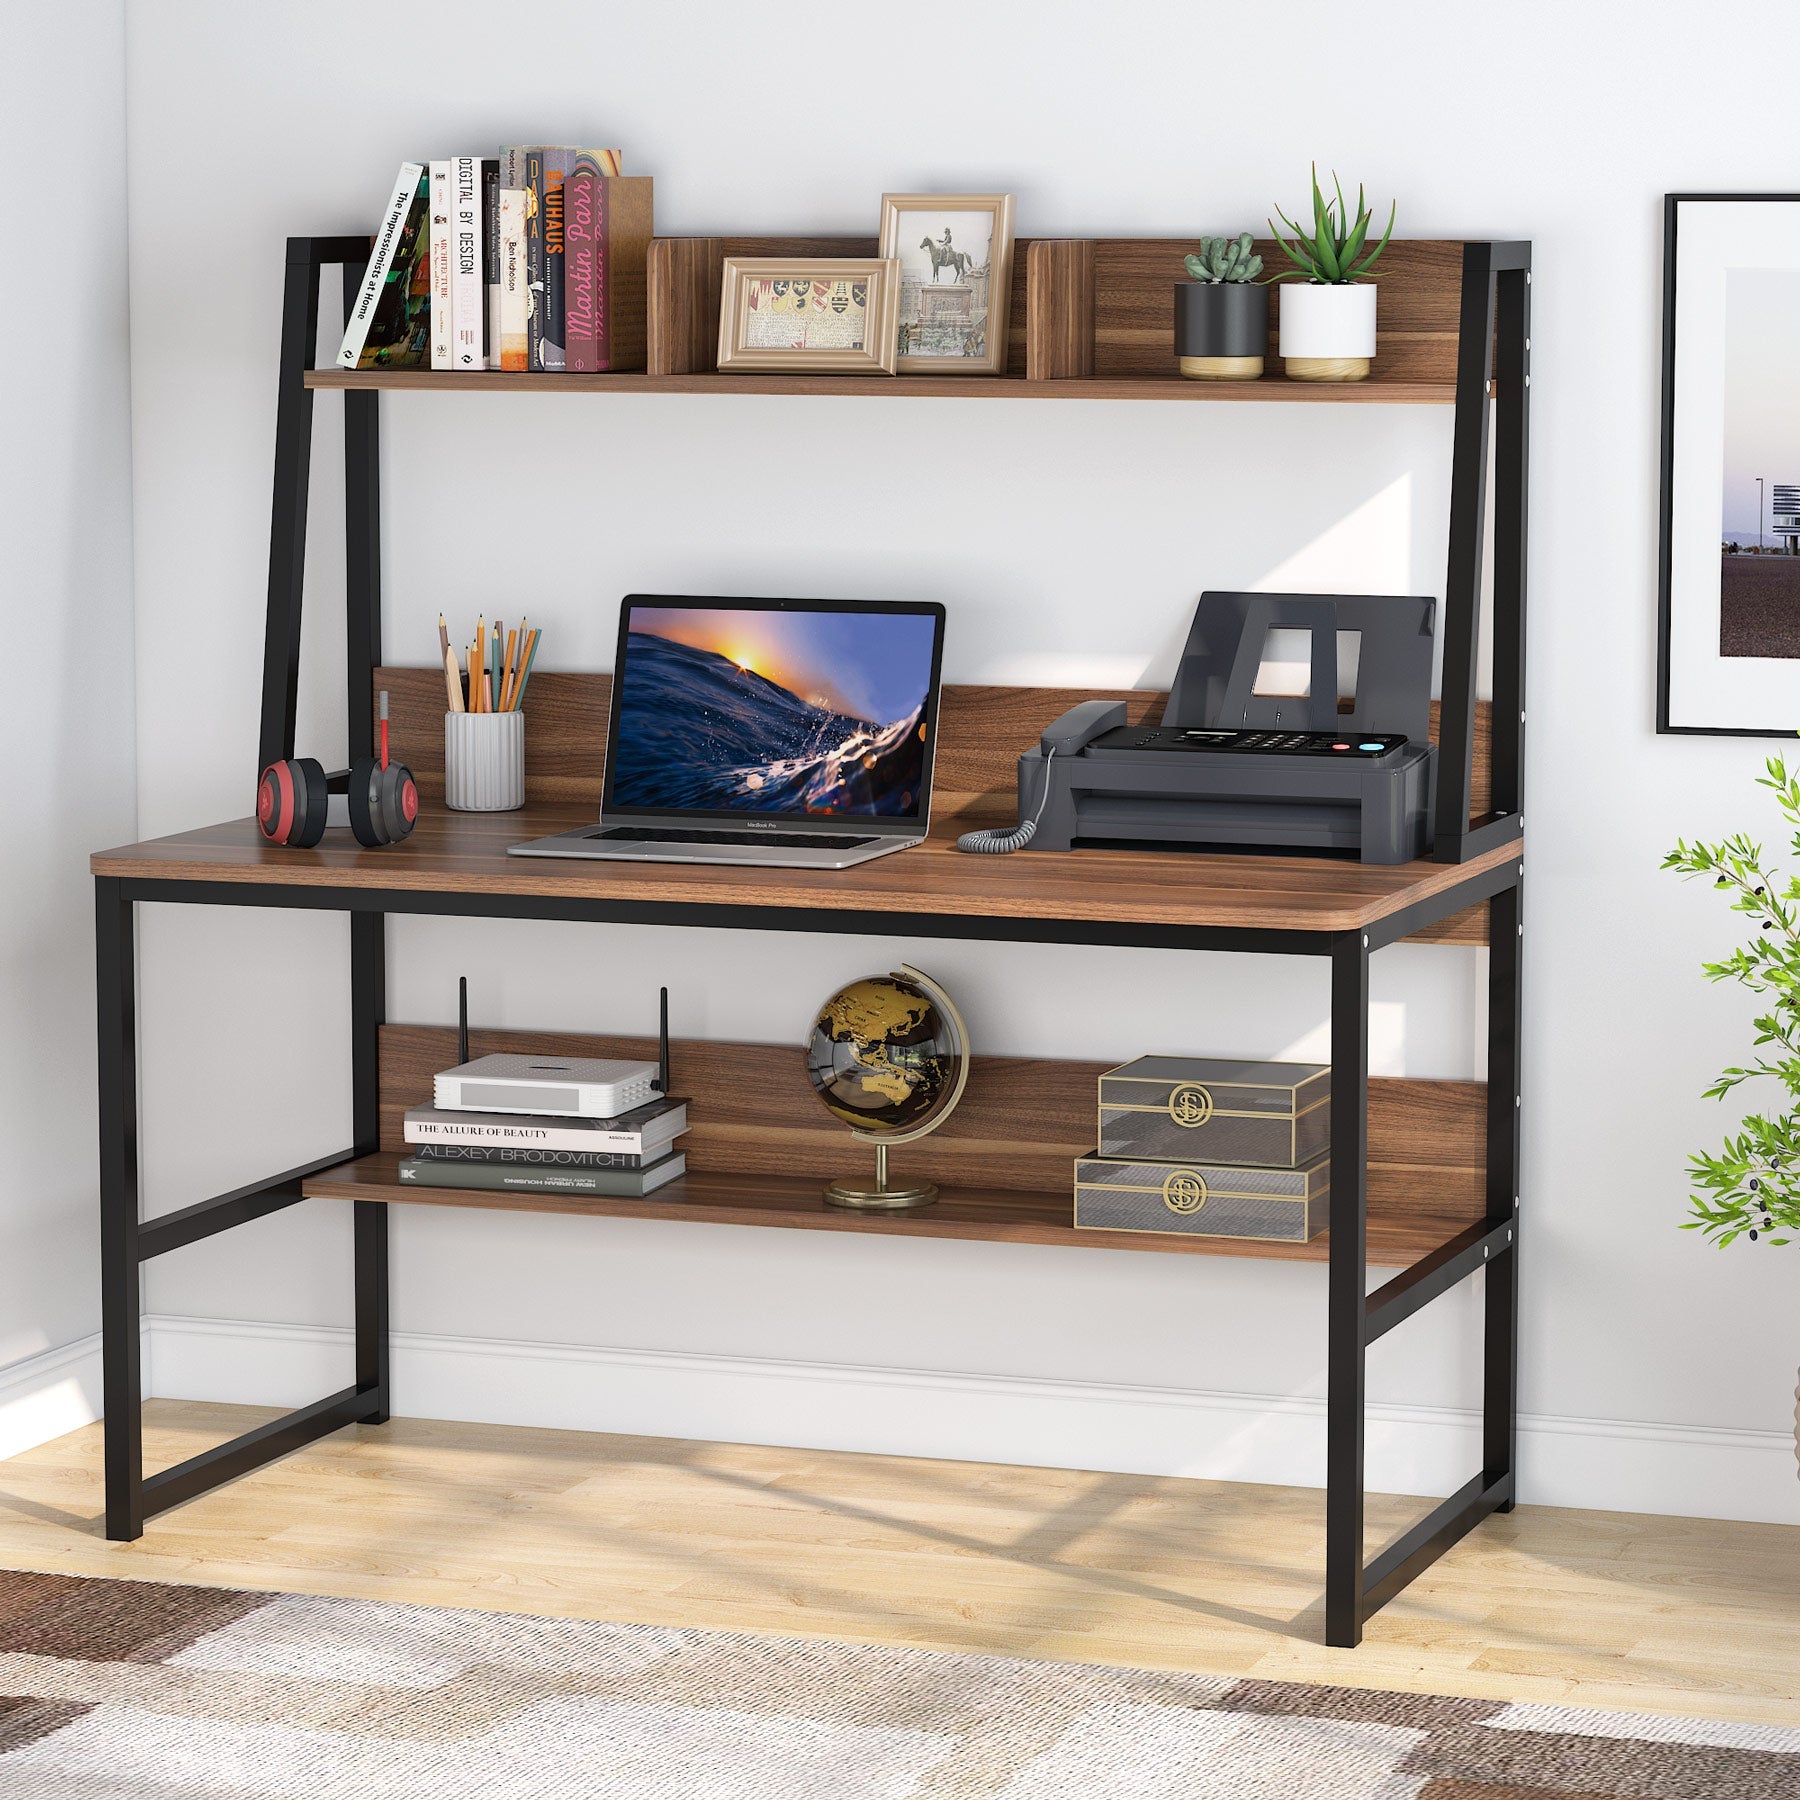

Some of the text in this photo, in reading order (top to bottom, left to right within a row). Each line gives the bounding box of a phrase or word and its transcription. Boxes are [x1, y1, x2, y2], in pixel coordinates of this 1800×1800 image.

[507, 169, 515, 187] Lynton
[530, 159, 539, 239] DADA
[458, 158, 474, 275] DIGITAL BY DESIGN
[545, 171, 564, 255] BAUHAUS
[566, 180, 592, 242] Parr
[357, 192, 409, 320] The Impressionists at Home
[440, 238, 448, 299] ARCHITECTURE
[507, 241, 517, 291] Ben Nicholson
[567, 248, 592, 336] Martin
[416, 1124, 549, 1139] THE ALLURE OF BEAUTY
[420, 1145, 625, 1167] ALEXEY BRODOVITCH
